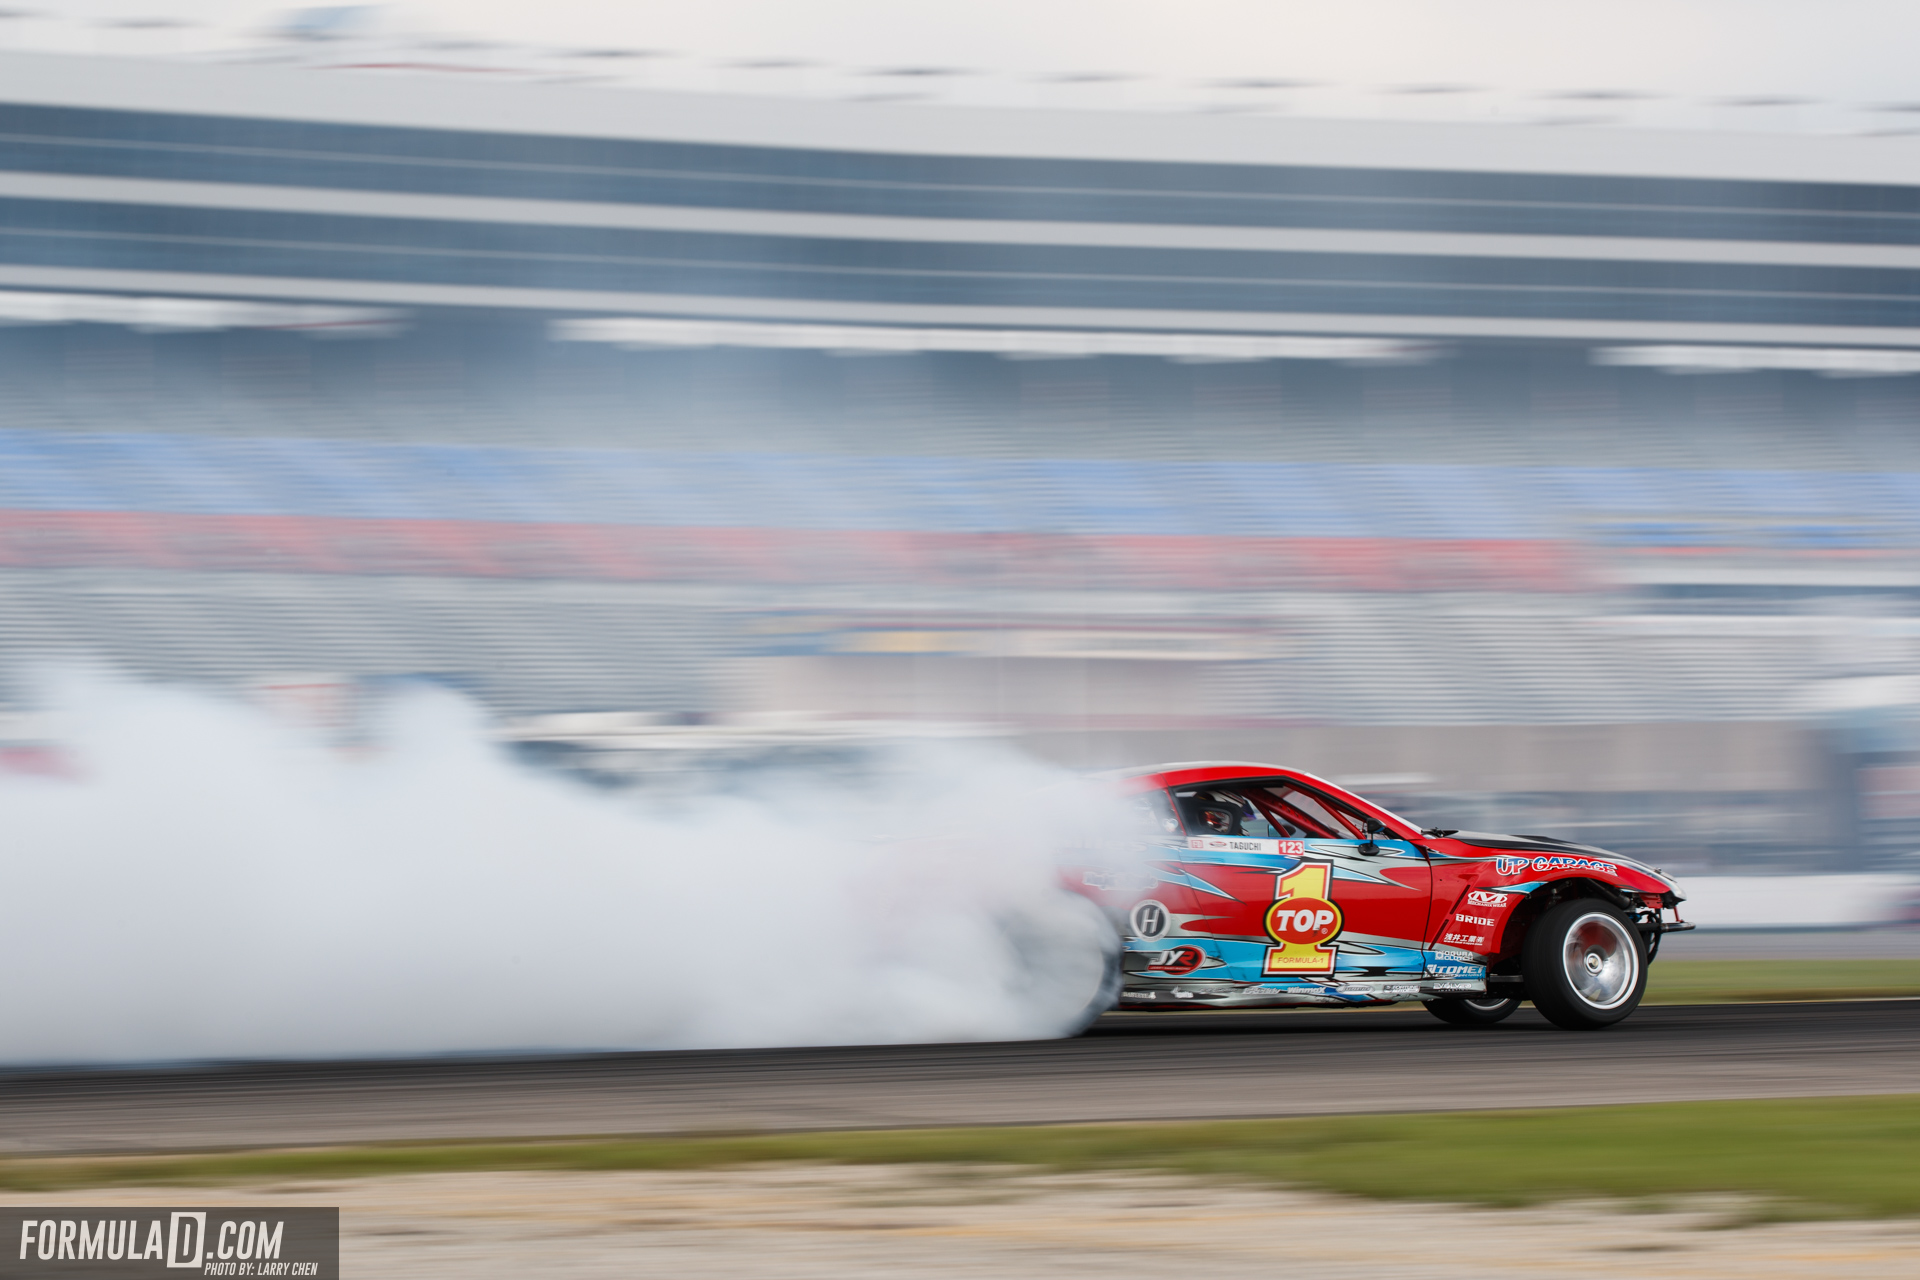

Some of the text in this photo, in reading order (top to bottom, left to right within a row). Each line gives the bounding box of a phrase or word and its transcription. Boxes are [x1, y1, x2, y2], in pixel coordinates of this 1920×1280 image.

[1229, 841, 1262, 851] TAGUCHI
[1280, 841, 1303, 854] 123
[1496, 856, 1618, 877] UP GARAGE
[1277, 909, 1334, 932] TOP
[1455, 913, 1495, 927] BRIDE
[1437, 965, 1484, 974] TOMEI
